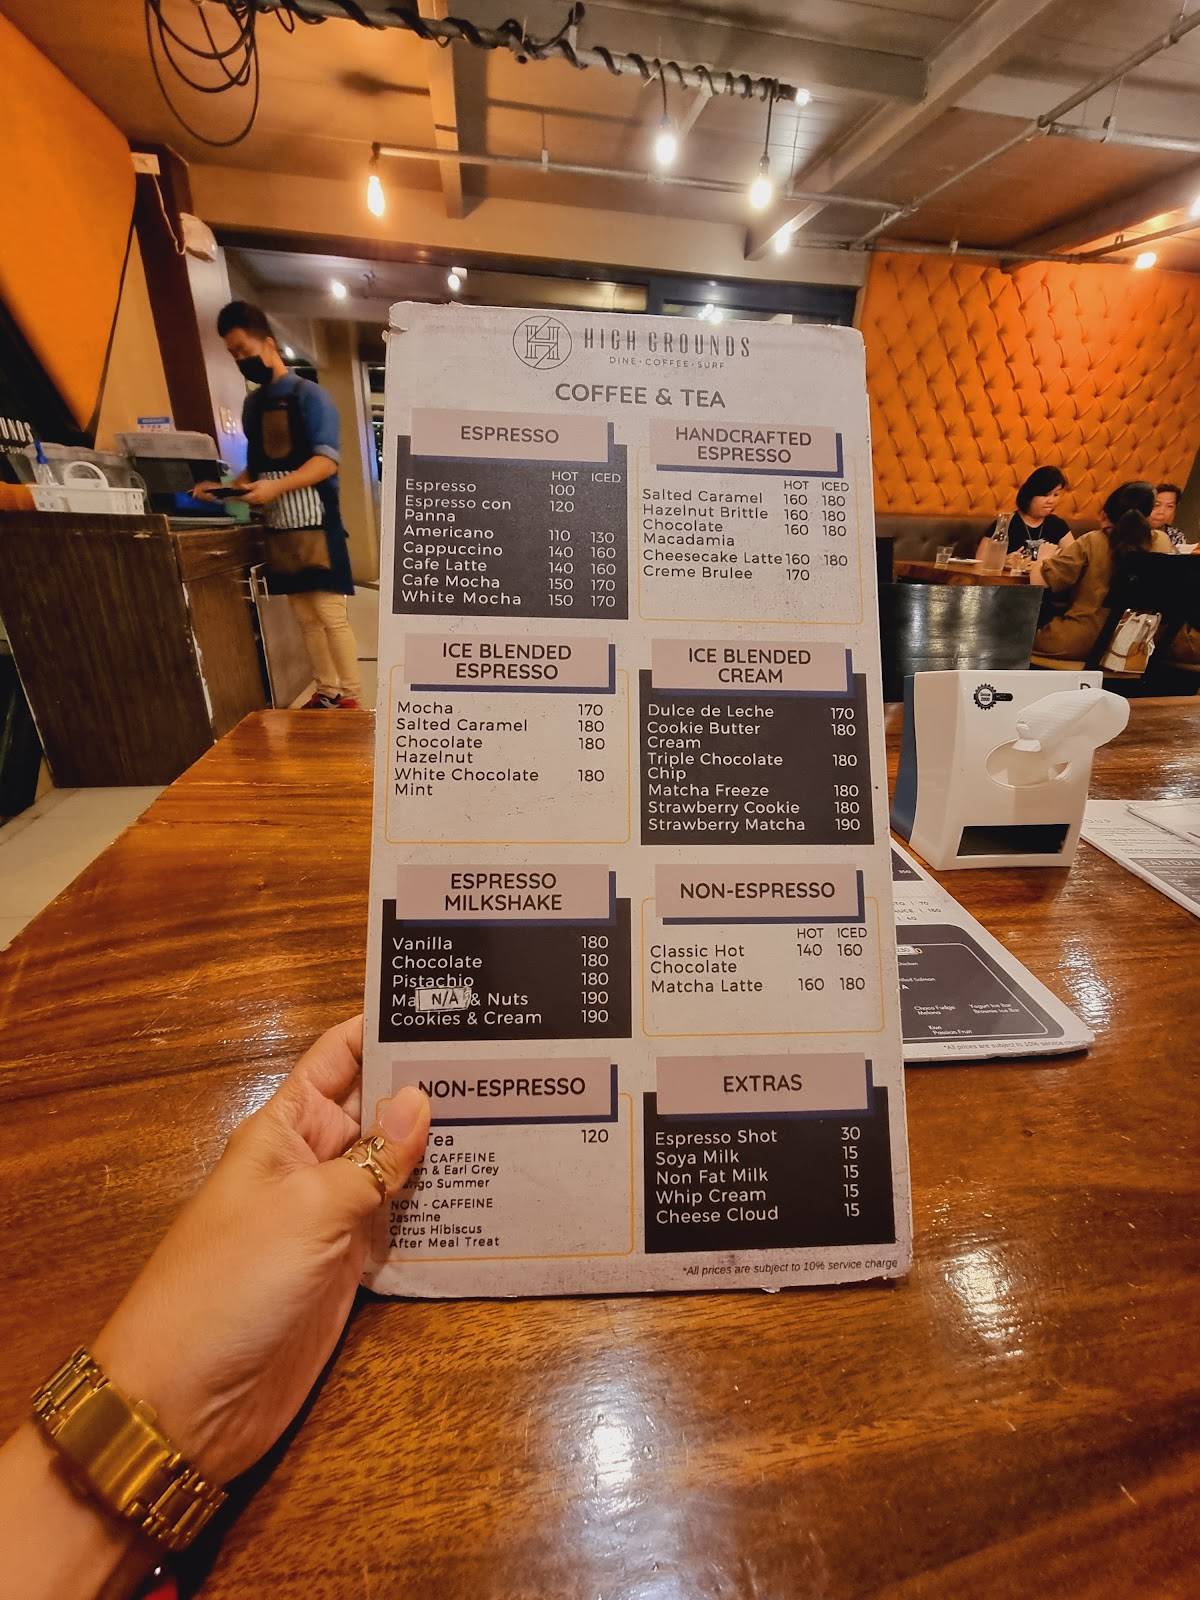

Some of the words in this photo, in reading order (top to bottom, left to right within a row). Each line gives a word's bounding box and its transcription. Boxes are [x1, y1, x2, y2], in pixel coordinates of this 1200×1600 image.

[584, 328, 636, 350] HIGH
[649, 331, 750, 357] GROUNDS
[610, 356, 637, 364] DINE
[646, 358, 689, 367] COFFEE
[698, 361, 725, 369] SURF
[555, 383, 647, 404] COFFEE
[655, 388, 672, 405] &
[681, 389, 725, 408] TEA
[461, 426, 559, 443] ESPRESSO
[676, 427, 812, 446] HANDCRAFTED
[698, 446, 792, 463] ESPRESSO
[551, 471, 578, 481] HOT
[591, 473, 621, 483] ICED
[405, 479, 477, 493] Espresso
[550, 485, 575, 496] 100
[784, 480, 809, 490] HOT
[821, 482, 849, 492] ICED
[405, 495, 476, 509] Espresso
[482, 499, 511, 510] con
[550, 501, 574, 512] 120
[642, 489, 692, 501] Salted
[698, 490, 763, 503] Caramel
[784, 494, 808, 505] 160
[822, 495, 845, 506] 180
[404, 509, 456, 522] Panna
[643, 504, 714, 517] Hazelnut
[720, 506, 768, 519] Brittle
[643, 519, 723, 532] Chocolate
[403, 525, 494, 539] Americano
[549, 530, 571, 541] 110
[591, 532, 615, 543] 130
[643, 533, 735, 546] Macadamia
[403, 542, 503, 556] Cappuccino
[549, 546, 573, 558] 140
[643, 549, 737, 563] Cheesecake
[744, 551, 782, 564] Latte
[785, 554, 810, 564] 160
[403, 558, 440, 570] Cafe
[445, 559, 487, 571] Latte
[644, 565, 695, 577] Creme
[702, 567, 753, 579] Brulee
[786, 569, 810, 580] 170
[402, 574, 439, 586] Cafe
[445, 575, 500, 588] Mocha
[549, 579, 573, 590] 150
[402, 591, 455, 603] White
[463, 592, 521, 605] Mocha
[443, 643, 472, 658] ICE
[480, 644, 572, 660] BLENDED
[689, 648, 716, 663] ICE
[724, 649, 811, 664] BLENDED
[456, 663, 559, 680] ESPRESSO
[719, 668, 783, 683] CREAM
[397, 701, 453, 714] Mocha
[578, 704, 603, 716] 170
[648, 704, 695, 716] Dulce
[701, 704, 721, 717] de
[727, 705, 774, 718] Leche
[831, 708, 854, 720] 170
[396, 718, 450, 731] Salted
[457, 719, 527, 732] Caramel
[578, 720, 604, 732] 180
[647, 722, 703, 734] Cookie
[709, 722, 760, 734] Butter
[832, 724, 856, 736] 180
[396, 736, 483, 748] Chocolate
[647, 736, 701, 748] Cream
[396, 751, 473, 763] Hazelnut
[648, 752, 694, 767] Triple
[700, 753, 783, 765] Chocolate
[395, 768, 445, 781] White
[452, 768, 539, 781] Chocolate
[578, 770, 604, 782] 180
[648, 767, 686, 782] Chip
[395, 783, 433, 796] Mint
[648, 784, 709, 796] Matcha
[716, 784, 769, 796] Freeze
[648, 801, 738, 816] Strawberry
[744, 801, 799, 813] Cookie
[648, 818, 738, 833] Strawberry
[745, 818, 805, 830] Matcha
[835, 819, 860, 830] 190
[451, 873, 556, 889] ESPRESSO
[680, 882, 835, 899] NON-ESPRESSO
[445, 895, 562, 911] MILKSHAKE
[797, 928, 824, 938] HOT
[838, 927, 867, 938] ICED
[393, 936, 452, 950] Vanilla
[581, 936, 608, 949] 180
[650, 944, 708, 958] Classic
[715, 945, 744, 957] Hot
[797, 944, 822, 956] 140
[838, 943, 863, 956] 160
[392, 955, 482, 969] Chocolate
[650, 960, 737, 974] Chocolate
[393, 973, 474, 987] Pistachio
[652, 979, 714, 993] Matcha
[721, 979, 763, 992] Latte
[431, 990, 459, 1007] N/A
[471, 993, 481, 1006] &
[488, 993, 528, 1006] Nuts
[581, 992, 608, 1004] 190
[391, 1011, 460, 1026] Cookies
[467, 1012, 478, 1025] &
[484, 1012, 541, 1024] Cream
[419, 1077, 586, 1098] NON-ESPRESSO
[724, 1074, 802, 1092] EXTRAS
[582, 1129, 608, 1143] 120
[655, 1131, 731, 1148] Espresso
[738, 1129, 777, 1143] Shot
[841, 1127, 860, 1140] 30
[430, 1153, 495, 1163] CAFFEINE
[656, 1152, 696, 1168] Soya
[703, 1150, 740, 1164] Milk
[843, 1146, 858, 1159] 15
[432, 1166, 439, 1175] &
[445, 1165, 466, 1174] Earl
[472, 1165, 499, 1176] Grey
[656, 1171, 692, 1184] Non
[700, 1170, 725, 1183] Fat
[732, 1168, 768, 1182] Milk
[437, 1179, 490, 1188] Summer
[390, 1200, 419, 1210] NON
[432, 1198, 493, 1209] CAFFEINE
[656, 1190, 702, 1206] Whip
[709, 1188, 766, 1202] Cream
[390, 1212, 440, 1223] Jasmine
[656, 1209, 720, 1224] Cheese
[727, 1206, 779, 1222] Cloud
[844, 1203, 860, 1217] 15
[390, 1225, 425, 1236] Citrus
[430, 1224, 482, 1234] Hibiscus
[389, 1238, 422, 1248] After
[429, 1236, 459, 1247] Meal
[465, 1237, 499, 1246] Treat
[702, 1265, 732, 1277] prices
[735, 1265, 750, 1274] are
[754, 1264, 788, 1276] subject
[791, 1263, 800, 1272] to
[803, 1261, 825, 1271] 10%
[828, 1260, 861, 1270] service
[865, 1258, 898, 1269] charge
